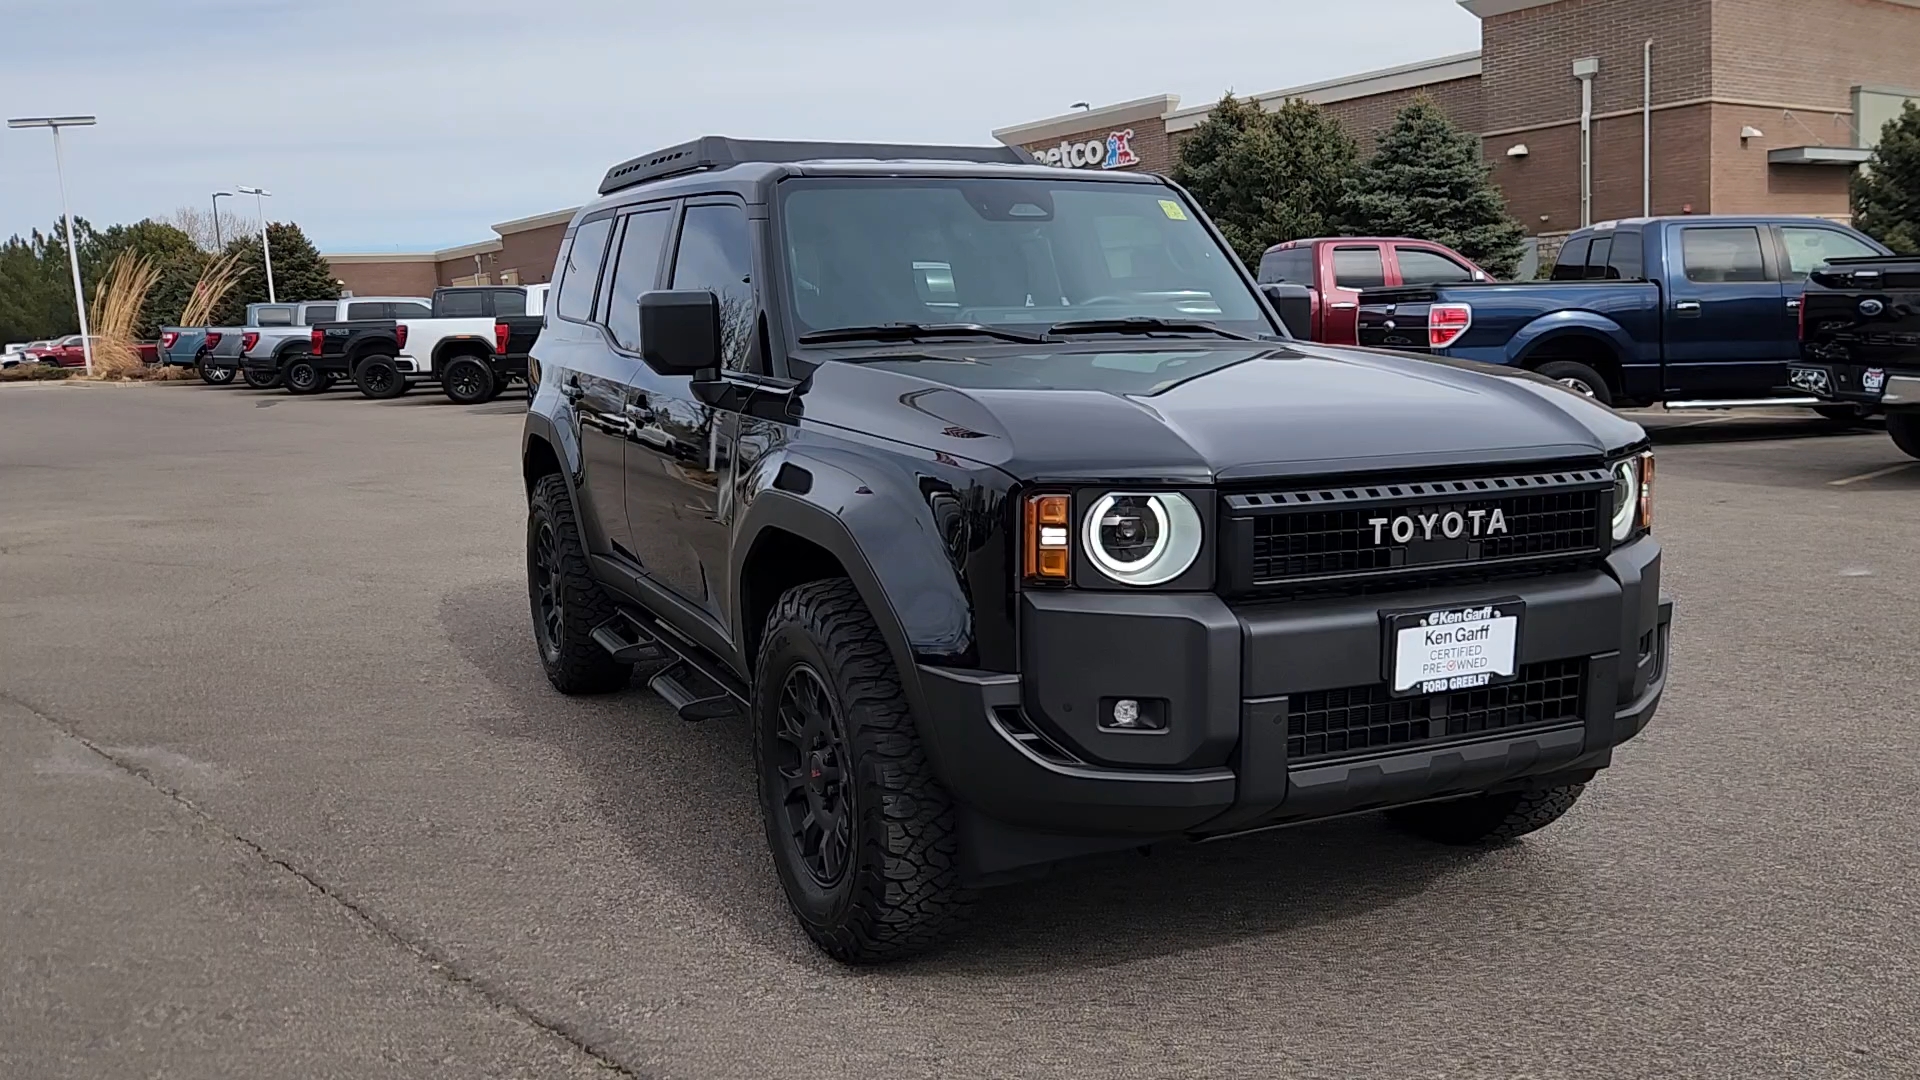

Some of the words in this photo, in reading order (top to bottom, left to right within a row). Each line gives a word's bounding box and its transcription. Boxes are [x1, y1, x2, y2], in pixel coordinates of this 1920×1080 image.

[1368, 508, 1507, 545] TOYOTA
[1439, 612, 1462, 625] Ken
[1463, 606, 1493, 622] Garff
[1425, 630, 1452, 646] Ken
[1455, 624, 1490, 642] Garff
[1430, 645, 1482, 661] CERTIFIED
[1422, 679, 1448, 694] FORD
[1449, 673, 1490, 690] GREELEY
